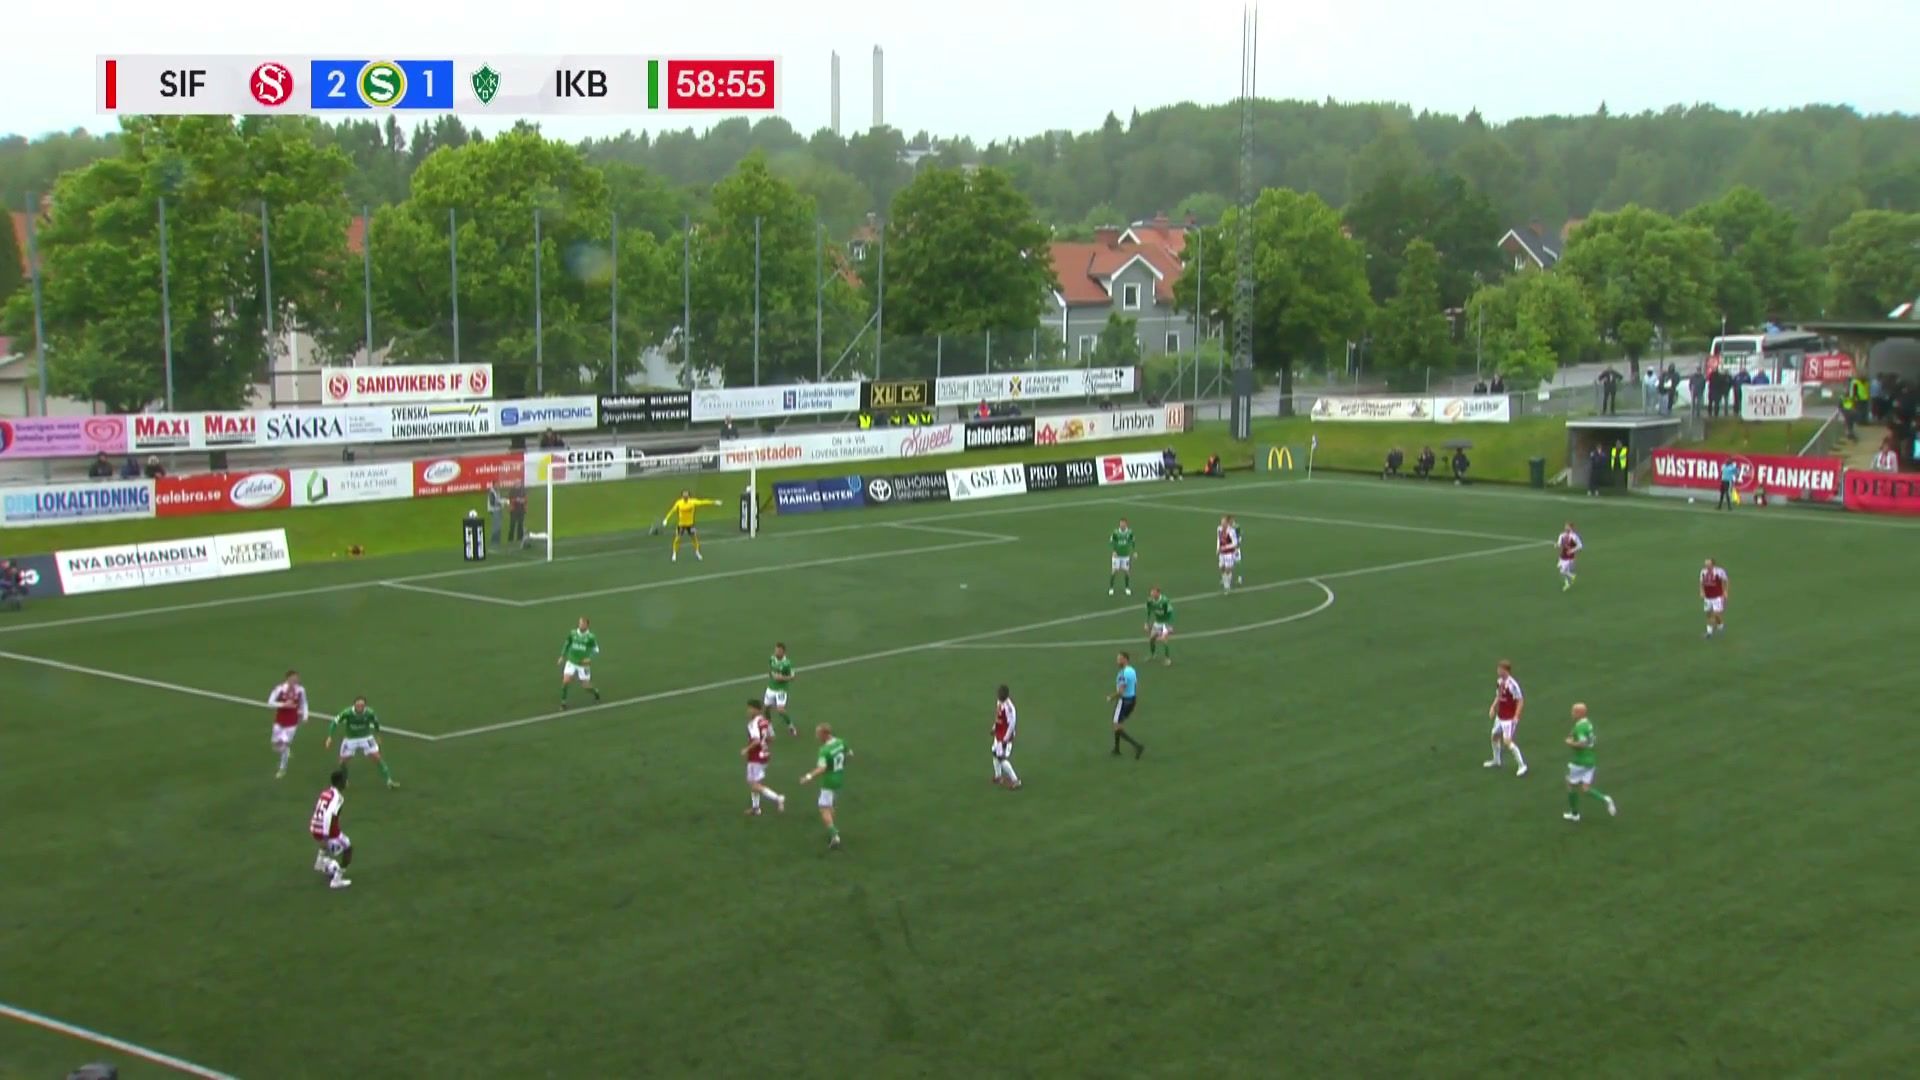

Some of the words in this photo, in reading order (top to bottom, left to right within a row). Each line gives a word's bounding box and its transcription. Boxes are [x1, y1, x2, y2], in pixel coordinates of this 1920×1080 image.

[356, 374, 446, 394] SANDVIKENS
[451, 373, 463, 390] IF
[391, 407, 429, 422] SVENSKA
[520, 407, 592, 421] SYNTRONIC
[1112, 412, 1154, 432] Limbra
[267, 413, 343, 440] SÄKRA
[391, 421, 475, 438] LINDNINGSMATERIAL
[479, 418, 489, 433] AB
[1030, 465, 1057, 480] PRIO
[1066, 462, 1093, 476] PRIO
[1655, 455, 1719, 479] VÄSTRA
[970, 472, 998, 489] GSE
[1002, 468, 1022, 485] AB
[1758, 465, 1834, 491] FLANKEN
[35, 486, 149, 512] LOKALTIDNING
[156, 489, 221, 504] celebra.se
[68, 557, 101, 571] NYA
[105, 545, 207, 567] BOKHANDELN
